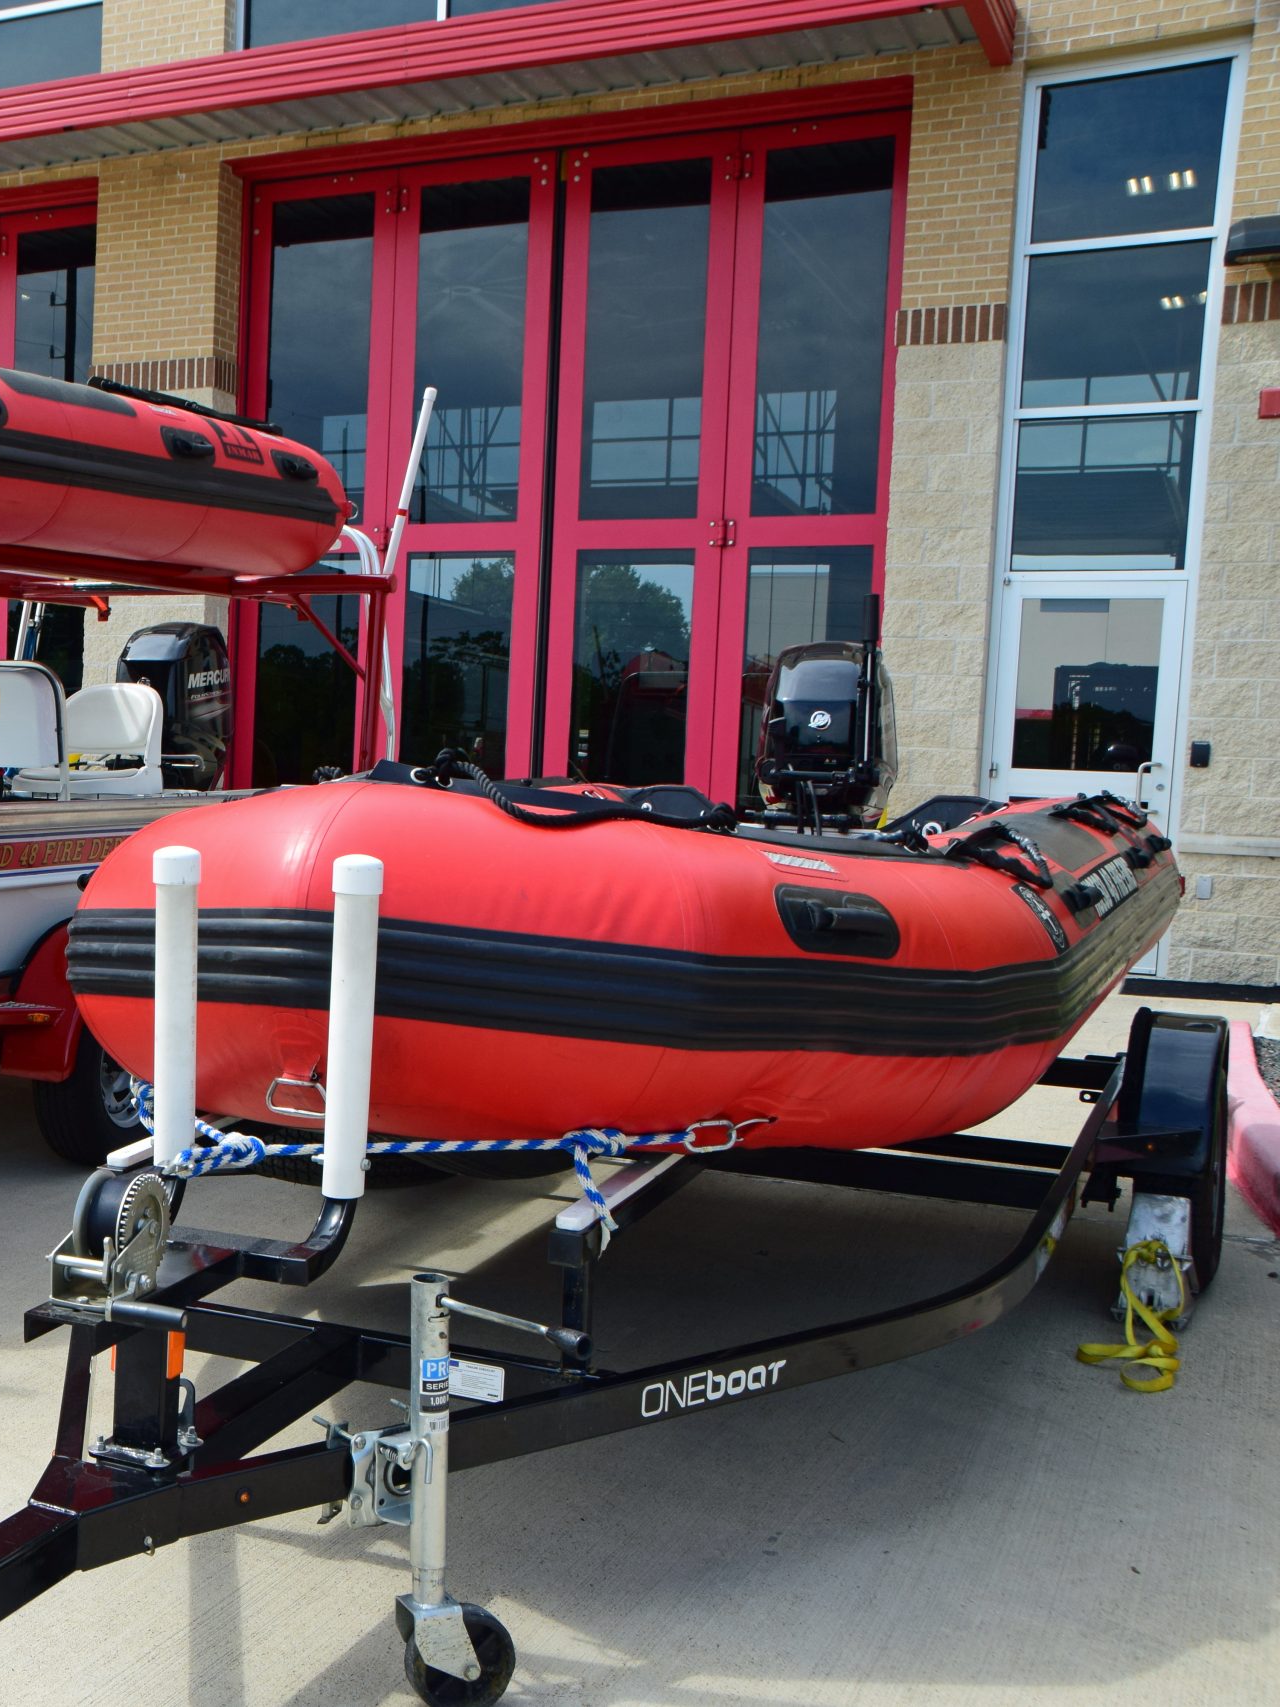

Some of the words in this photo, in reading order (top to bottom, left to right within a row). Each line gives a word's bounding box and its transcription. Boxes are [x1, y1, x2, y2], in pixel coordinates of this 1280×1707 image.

[187, 667, 230, 690] MERCUR
[20, 843, 39, 866] 48
[42, 838, 86, 864] FIRE
[426, 1361, 449, 1378] PR
[426, 1380, 449, 1391] SERIE
[641, 1359, 787, 1418] ONEboat
